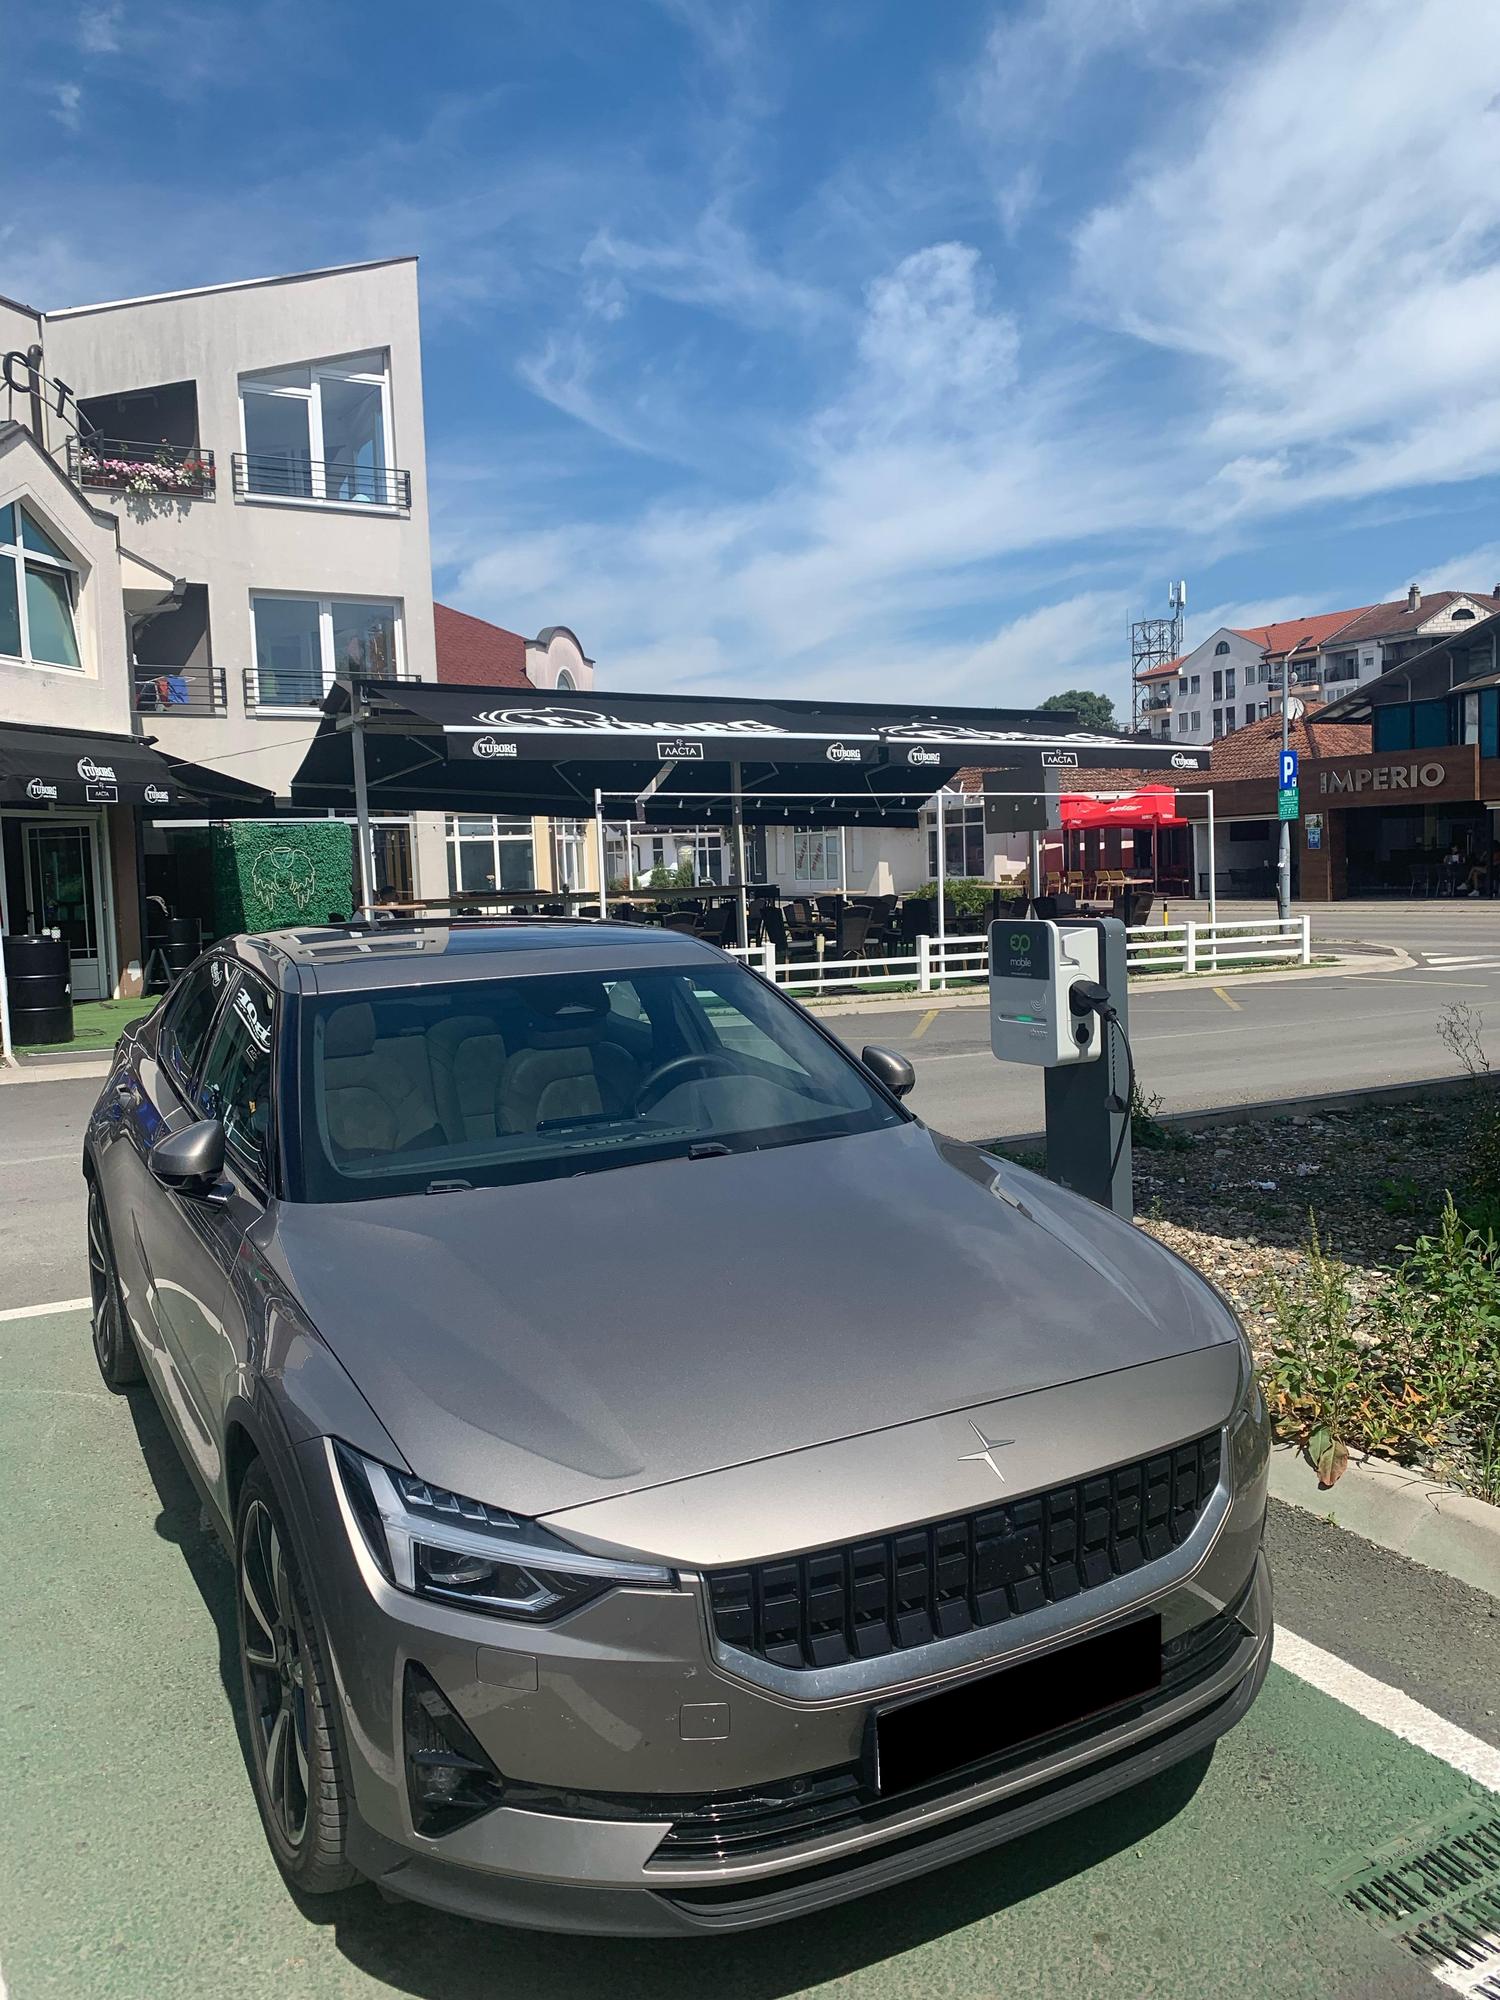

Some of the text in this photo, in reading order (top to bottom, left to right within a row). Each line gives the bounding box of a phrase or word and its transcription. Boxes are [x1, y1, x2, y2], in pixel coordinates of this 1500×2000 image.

[480, 743, 517, 754] TUBORG
[831, 748, 861, 758] TUBORG
[912, 752, 940, 762] TUBORG
[1174, 757, 1199, 766] TUBORG
[82, 765, 116, 779] TUBORG
[1283, 756, 1294, 784] P
[1320, 762, 1445, 794] IMPERIO
[32, 785, 58, 796] TUBORG
[148, 790, 169, 800] TUBORG
[1010, 957, 1032, 968] mobile
